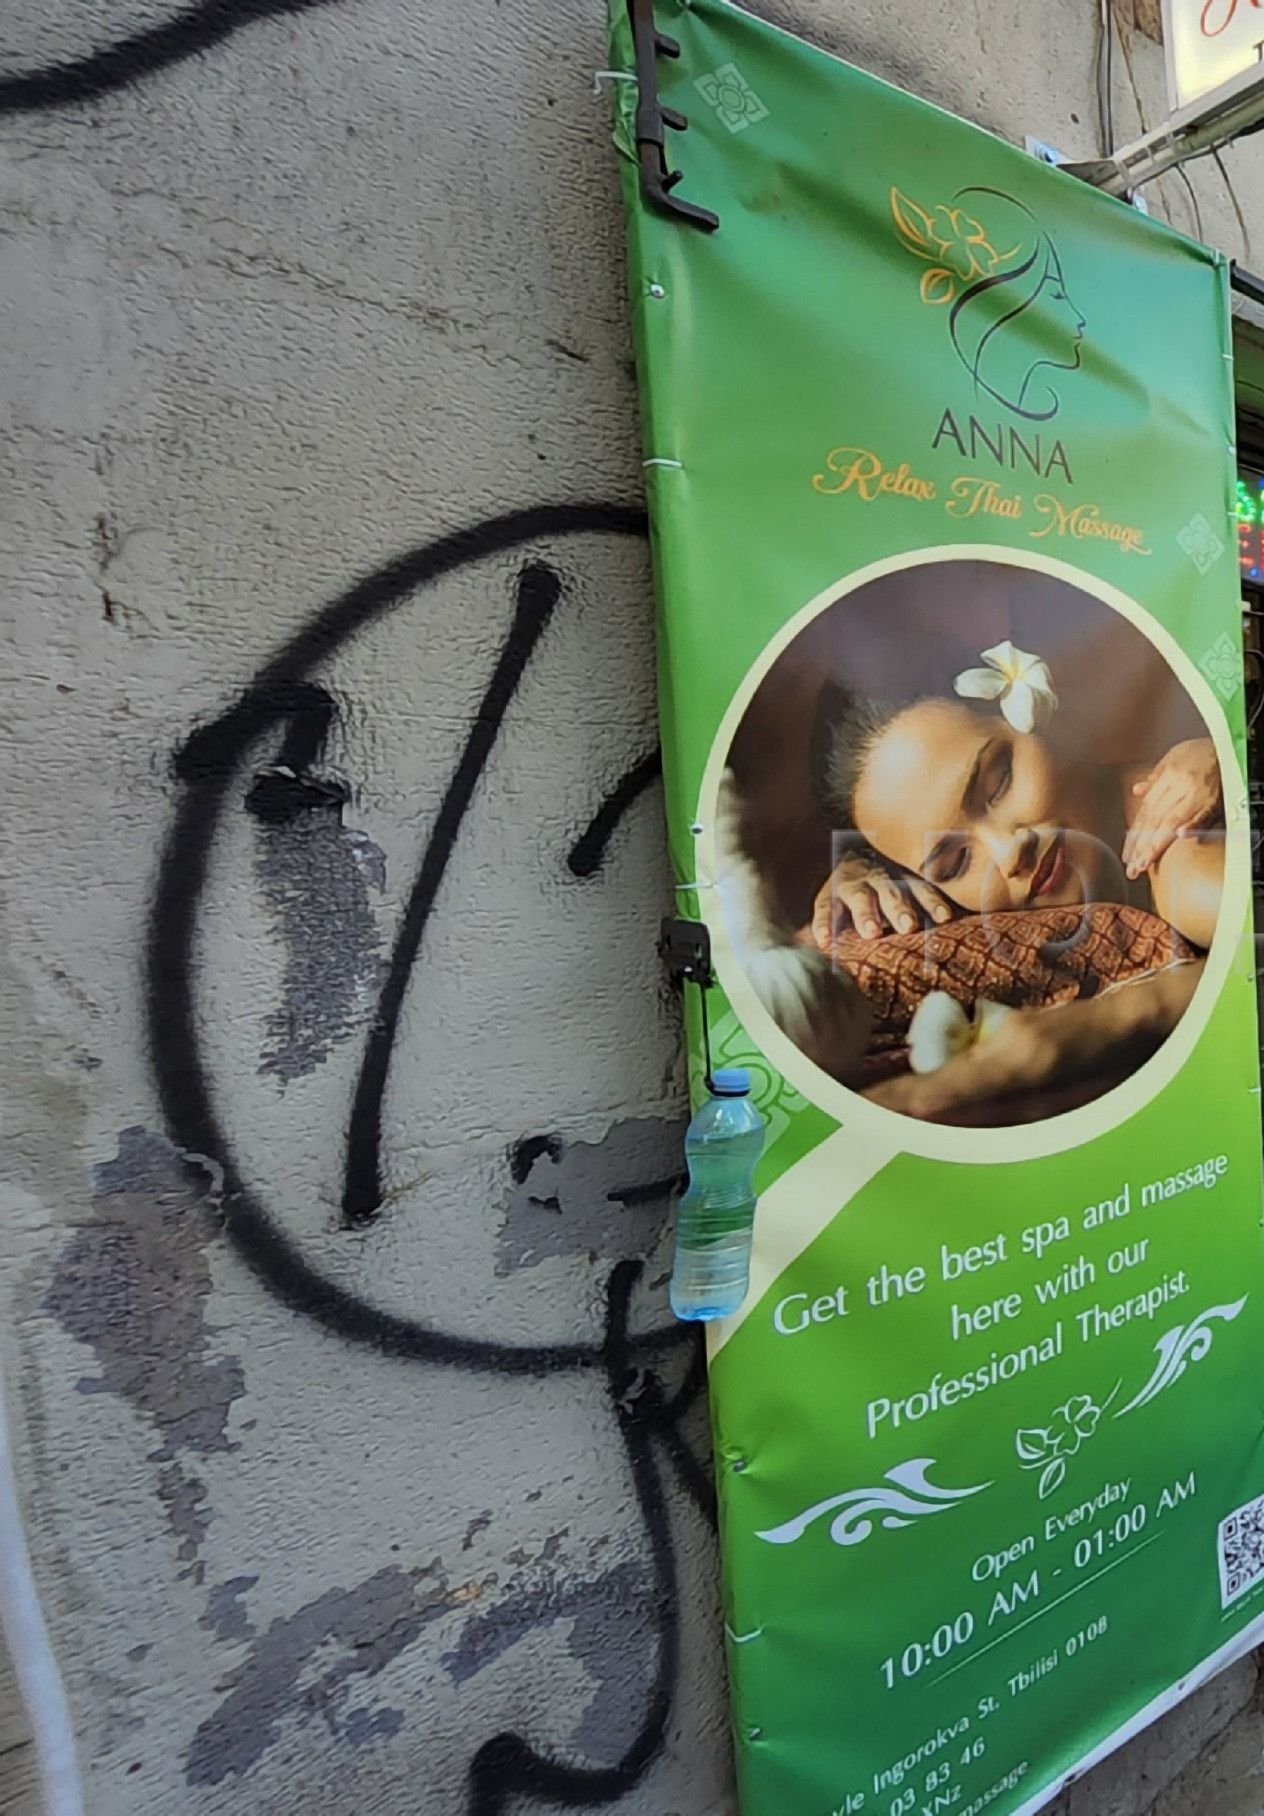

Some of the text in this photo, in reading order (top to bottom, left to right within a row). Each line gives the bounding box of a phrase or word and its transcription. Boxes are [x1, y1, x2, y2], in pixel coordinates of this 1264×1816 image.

[811, 445, 1152, 556] Relax Thai Massage
[932, 407, 1073, 485] ANNA
[771, 1154, 1228, 1337] Get the best spa and massage
[950, 1238, 1150, 1341] here with our
[864, 1270, 1190, 1440] Professional Therapist.
[880, 1611, 975, 1689] 10:00
[987, 1569, 1040, 1626] AM
[1073, 1503, 1147, 1569] 01:00
[1155, 1471, 1196, 1518] AM
[971, 1477, 1131, 1582] Open Everyday
[872, 1716, 970, 1795] Ingorokva
[977, 1696, 1000, 1719] St.
[1007, 1649, 1058, 1696] Tbilisi
[925, 1761, 951, 1793] 83
[959, 1736, 986, 1765] 46
